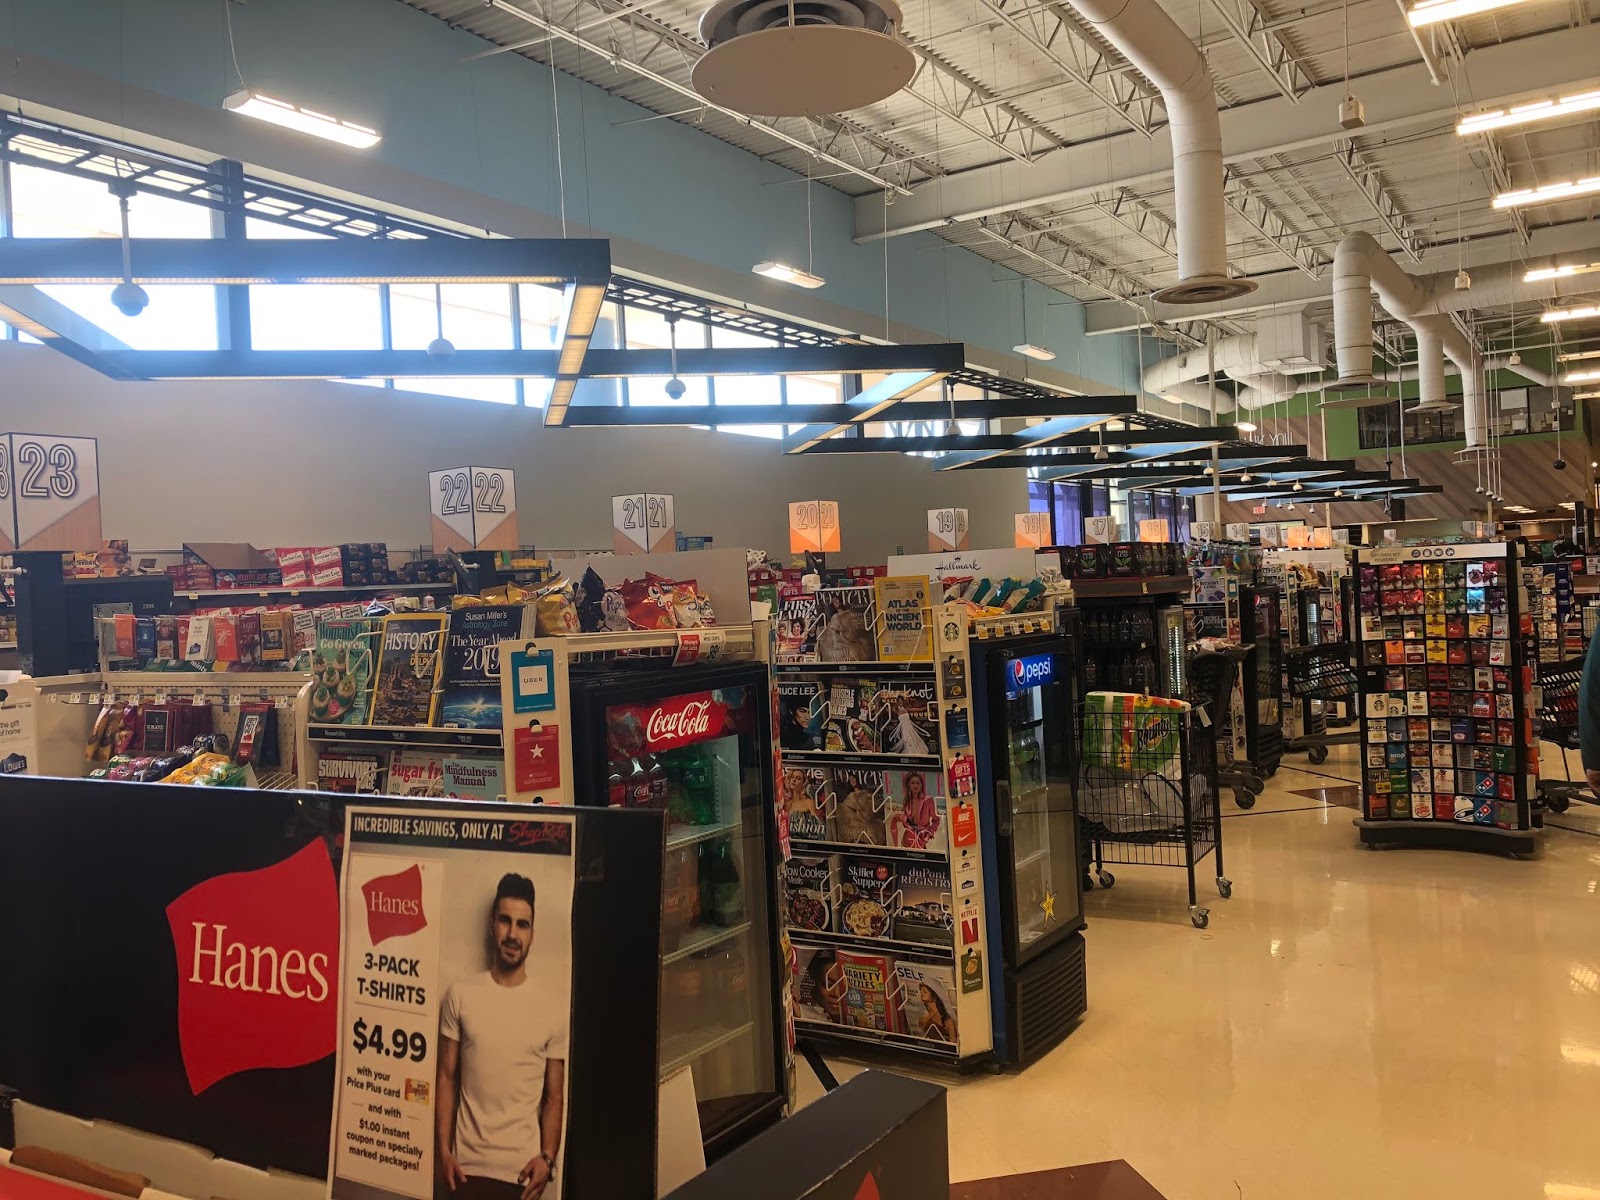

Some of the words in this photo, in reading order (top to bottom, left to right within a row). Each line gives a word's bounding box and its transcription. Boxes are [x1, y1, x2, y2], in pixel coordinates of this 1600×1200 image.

[19, 441, 78, 498] 23
[440, 473, 470, 515] 22
[475, 472, 505, 512] 22
[623, 498, 645, 529] 21
[648, 498, 667, 528] 21
[797, 504, 818, 529] 20
[821, 504, 835, 529] 20
[955, 511, 965, 532] 19
[936, 511, 953, 533] 19
[1022, 515, 1039, 534] 18
[1092, 518, 1107, 535] 17
[1197, 523, 1209, 538] 15
[1232, 524, 1244, 537] 14
[935, 559, 981, 576] Hallmark
[888, 599, 918, 608] ATLAS
[465, 612, 485, 621] Susan
[486, 611, 507, 620] Miller's
[462, 621, 491, 629] Astrology
[887, 622, 922, 631] WORLD
[321, 639, 335, 649] Go
[384, 633, 437, 650] HISTORY
[451, 635, 469, 647] The
[469, 634, 487, 647] Year
[190, 661, 208, 672] mints
[462, 648, 500, 671] 2019
[1026, 657, 1051, 682] pepsi
[777, 687, 798, 695] RUCE
[800, 686, 816, 695] LEE
[10, 720, 19, 728] gift
[647, 700, 711, 742] Coca-Cola
[1137, 717, 1170, 753] Bounty
[319, 759, 377, 779] SURVIVOR'S
[391, 763, 425, 783] sugar
[445, 765, 497, 777] Mindfulness
[453, 775, 486, 787] Manual
[354, 816, 410, 835] INCREDIBLE
[412, 820, 459, 840] SAVINGS,
[461, 822, 491, 840] ONLY
[491, 824, 504, 840] AT
[508, 820, 568, 846] ShopRite
[799, 865, 829, 879] Cooker
[848, 866, 874, 879] Skillet
[909, 867, 946, 880] duPont
[788, 877, 803, 885] Meals
[852, 876, 886, 888] Suppers
[901, 875, 951, 888] REGISTRY
[370, 891, 419, 915] Hanes
[961, 909, 977, 918] NETFLIX
[189, 921, 328, 1002] Hanes
[364, 952, 420, 977] 3-PACK
[843, 969, 881, 981] VARIETY
[897, 967, 925, 982] SELF
[357, 977, 426, 1005] T-SHIRTS
[353, 1017, 427, 1063] $4.99
[357, 1066, 372, 1078] with
[374, 1071, 391, 1081] your
[347, 1077, 364, 1090] Price
[366, 1081, 382, 1094] Plus
[383, 1088, 400, 1098] card
[368, 1103, 382, 1115] and
[384, 1107, 402, 1119] with
[359, 1119, 381, 1133] $1.00
[382, 1124, 410, 1140] instant
[346, 1131, 375, 1145] coupon
[376, 1139, 387, 1149] on
[388, 1142, 423, 1159] specially
[349, 1146, 377, 1160] marked
[379, 1154, 420, 1171] packages!
